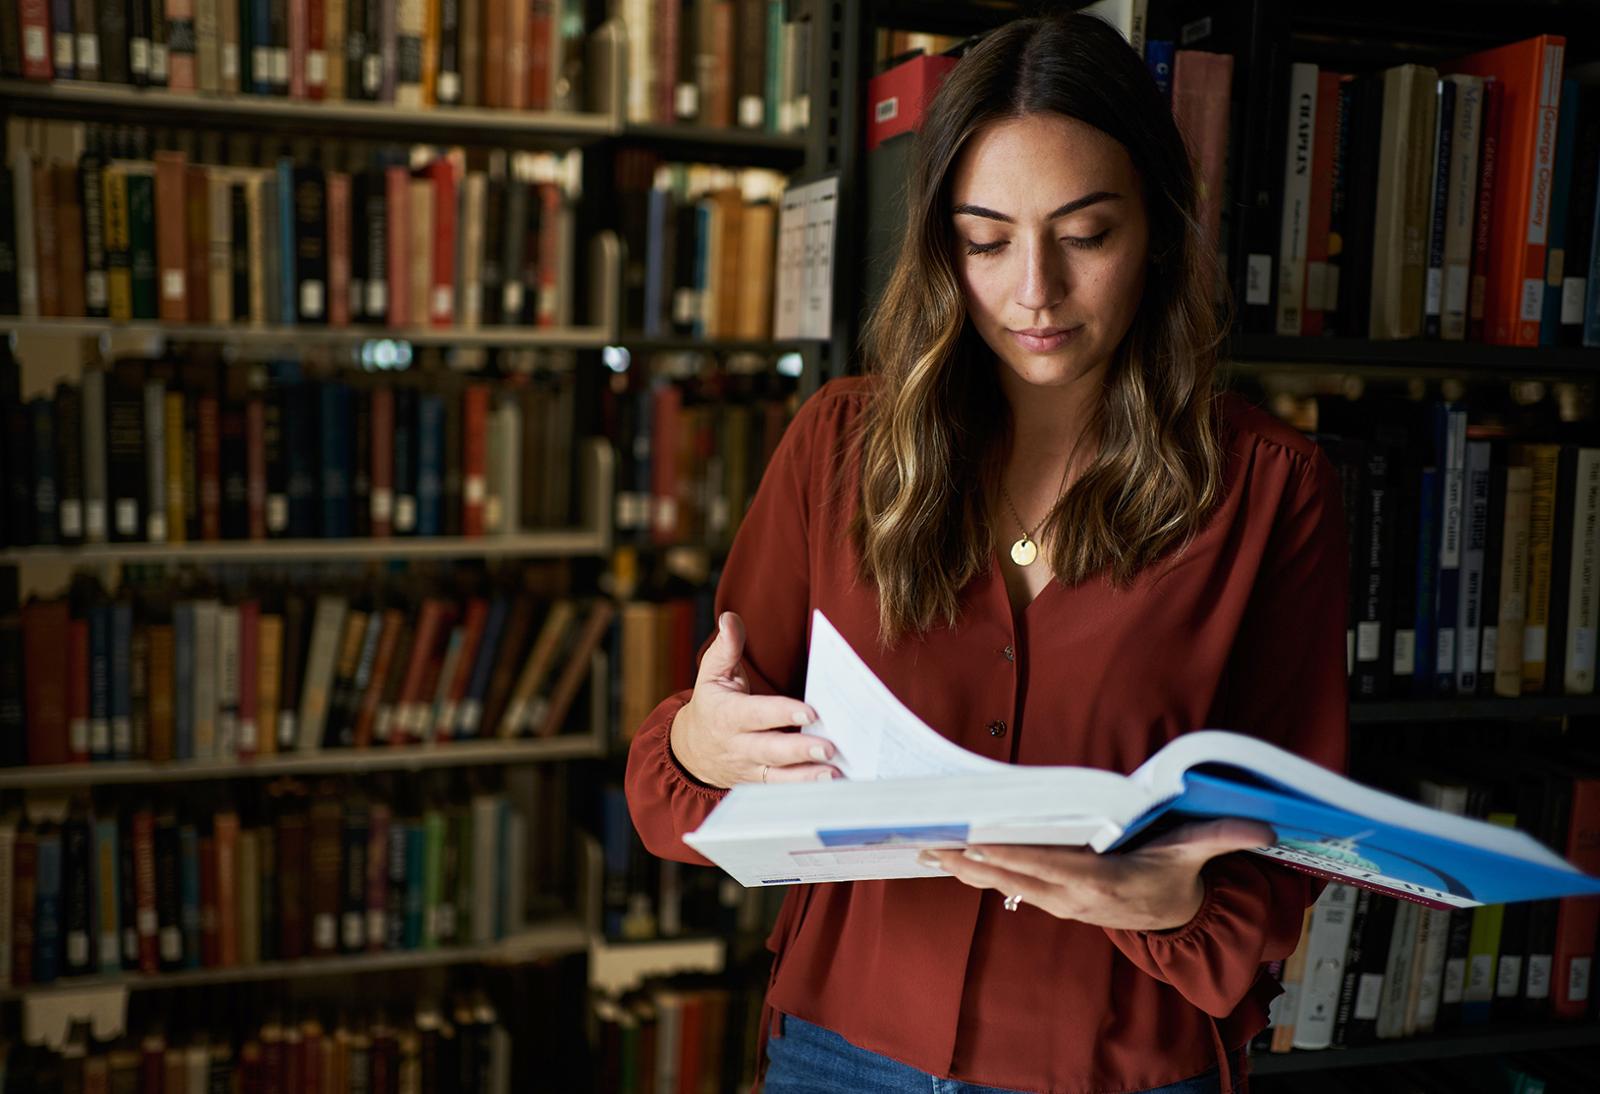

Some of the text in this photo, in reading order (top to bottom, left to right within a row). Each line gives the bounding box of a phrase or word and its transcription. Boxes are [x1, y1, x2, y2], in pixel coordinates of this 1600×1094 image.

[1296, 93, 1312, 176] CHAPLIN
[1461, 85, 1478, 142] Monty
[1541, 108, 1557, 164] George
[1477, 136, 1496, 254] GEORGE CLOONEY
[1533, 167, 1552, 228] Clooney
